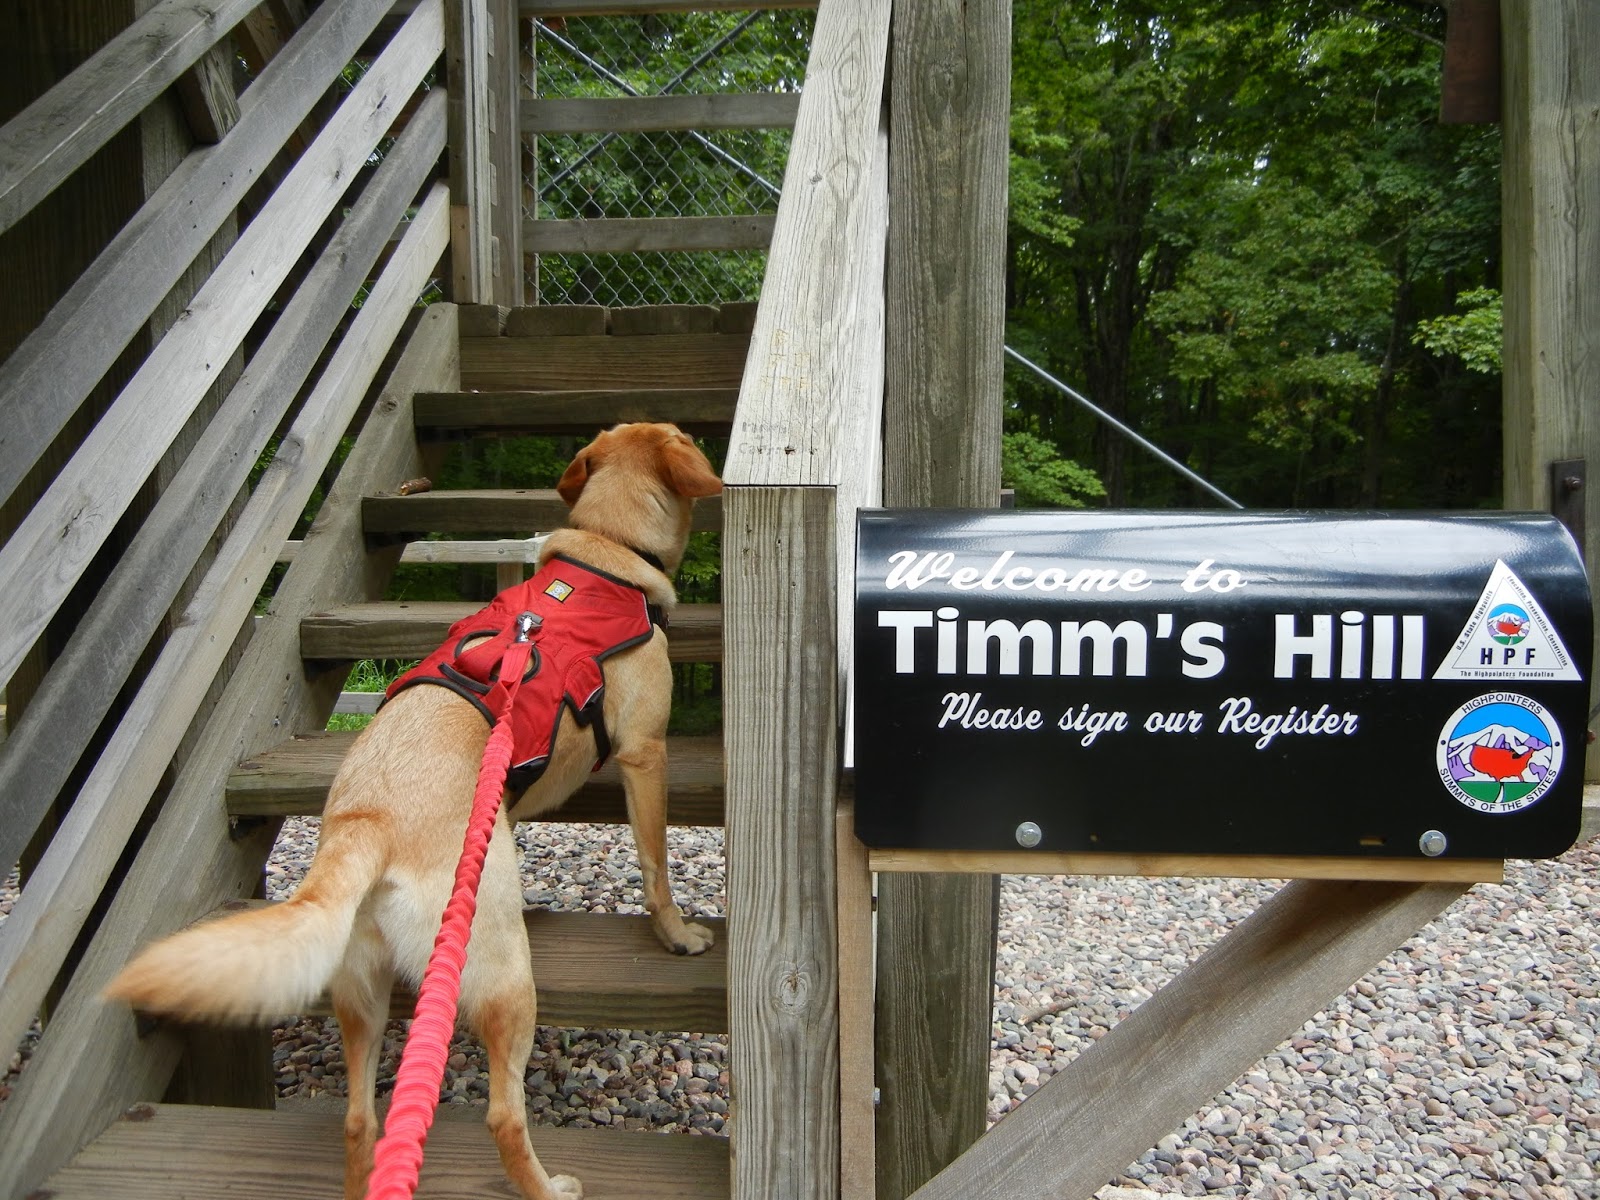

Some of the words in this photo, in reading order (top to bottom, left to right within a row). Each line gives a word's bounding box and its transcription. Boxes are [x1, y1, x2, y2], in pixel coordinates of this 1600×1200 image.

[885, 550, 1151, 592] Welcome
[1180, 558, 1247, 593] to
[1456, 639, 1467, 651] U.S.
[1464, 623, 1477, 639] State
[1475, 590, 1493, 620] Highpoints
[877, 606, 1225, 679] Timm's
[1274, 610, 1424, 680] Hill
[1548, 634, 1568, 667] Conservation
[1474, 670, 1516, 678] Highpointers
[938, 692, 1044, 730] Please
[1058, 703, 1128, 747] sign
[1143, 710, 1203, 734] our
[1218, 696, 1359, 750] Register
[1461, 693, 1543, 714] HIGHPOINTERS
[1440, 767, 1476, 807] SUMMITS
[1480, 802, 1496, 811] OF
[1500, 800, 1523, 812] THE
[1526, 769, 1557, 803] STATES
